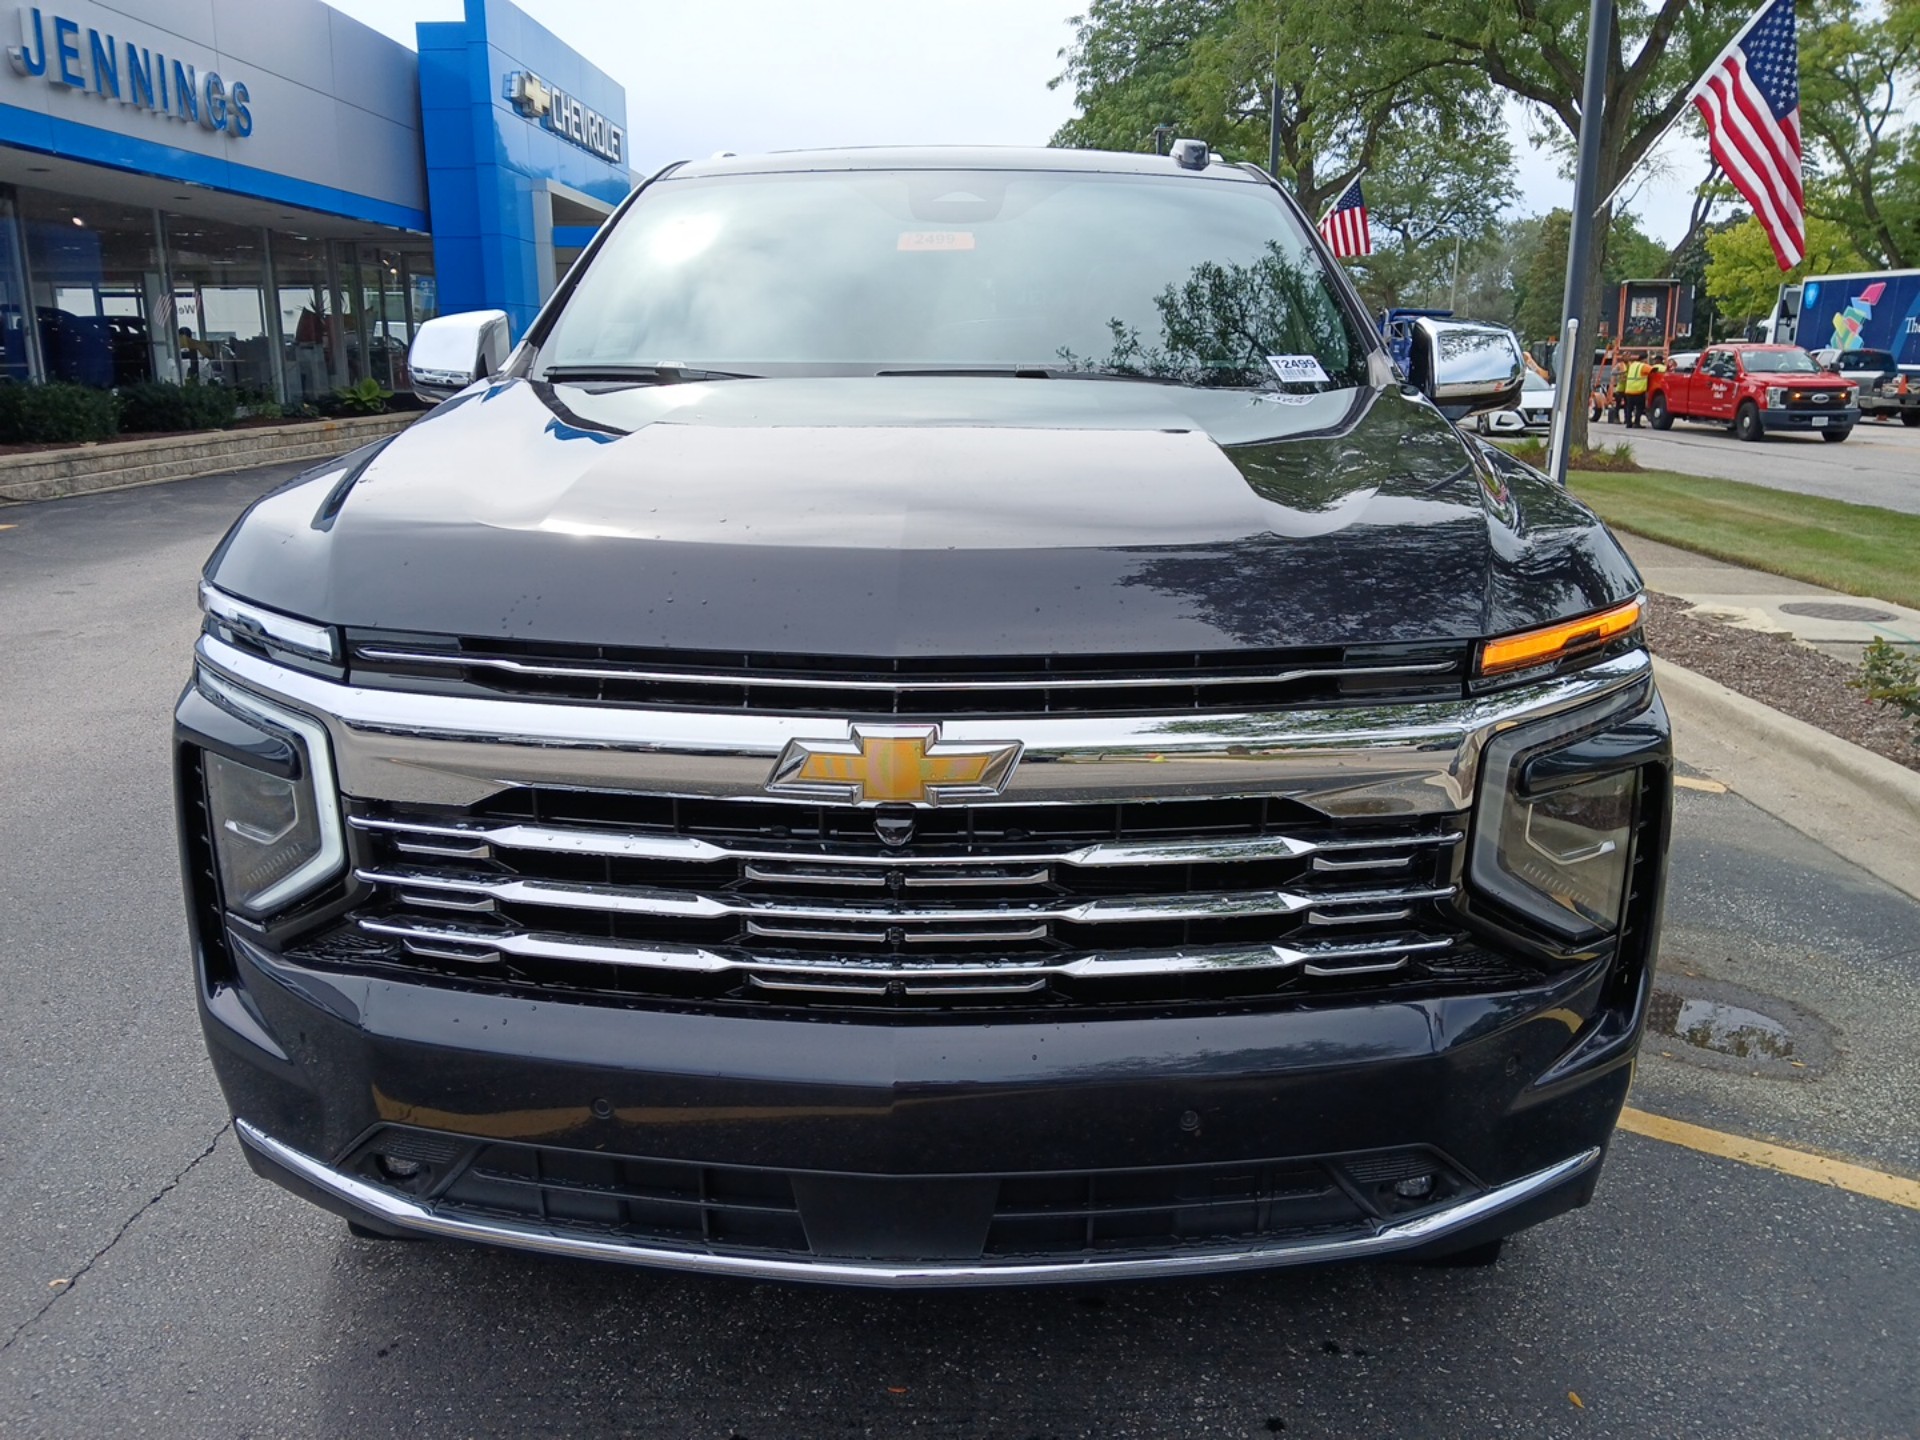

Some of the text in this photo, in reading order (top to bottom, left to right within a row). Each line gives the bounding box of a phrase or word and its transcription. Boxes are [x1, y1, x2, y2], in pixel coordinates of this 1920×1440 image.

[10, 7, 253, 138] JENNINGS
[551, 86, 624, 164] CHEVROLET
[914, 233, 956, 245] 2499
[1272, 359, 1316, 369] T2499
